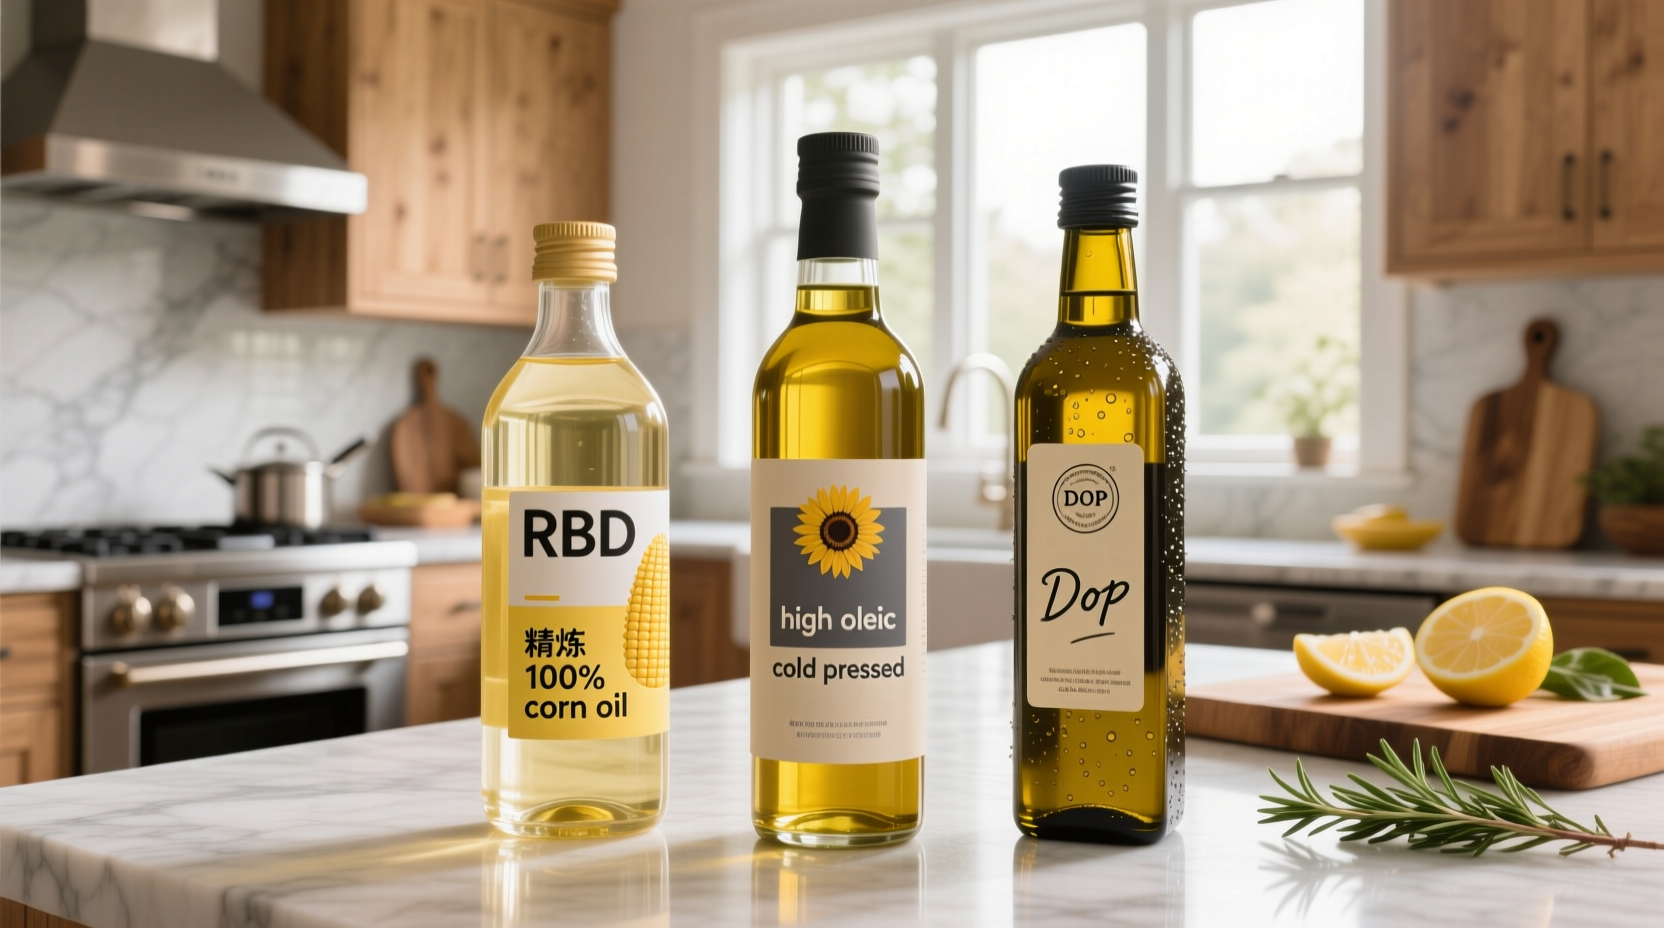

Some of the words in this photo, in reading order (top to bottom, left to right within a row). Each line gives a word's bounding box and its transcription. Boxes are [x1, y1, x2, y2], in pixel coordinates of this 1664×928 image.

[1064, 490, 1108, 506] DOP
[524, 509, 636, 557] RBD
[1040, 567, 1130, 627] Dop
[781, 605, 833, 637] high
[840, 605, 897, 631] oleic
[524, 627, 586, 658] 精炼
[525, 664, 605, 690] 100%
[772, 656, 816, 679] cold
[823, 655, 905, 685] pressed
[524, 699, 587, 719] corn
[596, 692, 627, 719] oil
